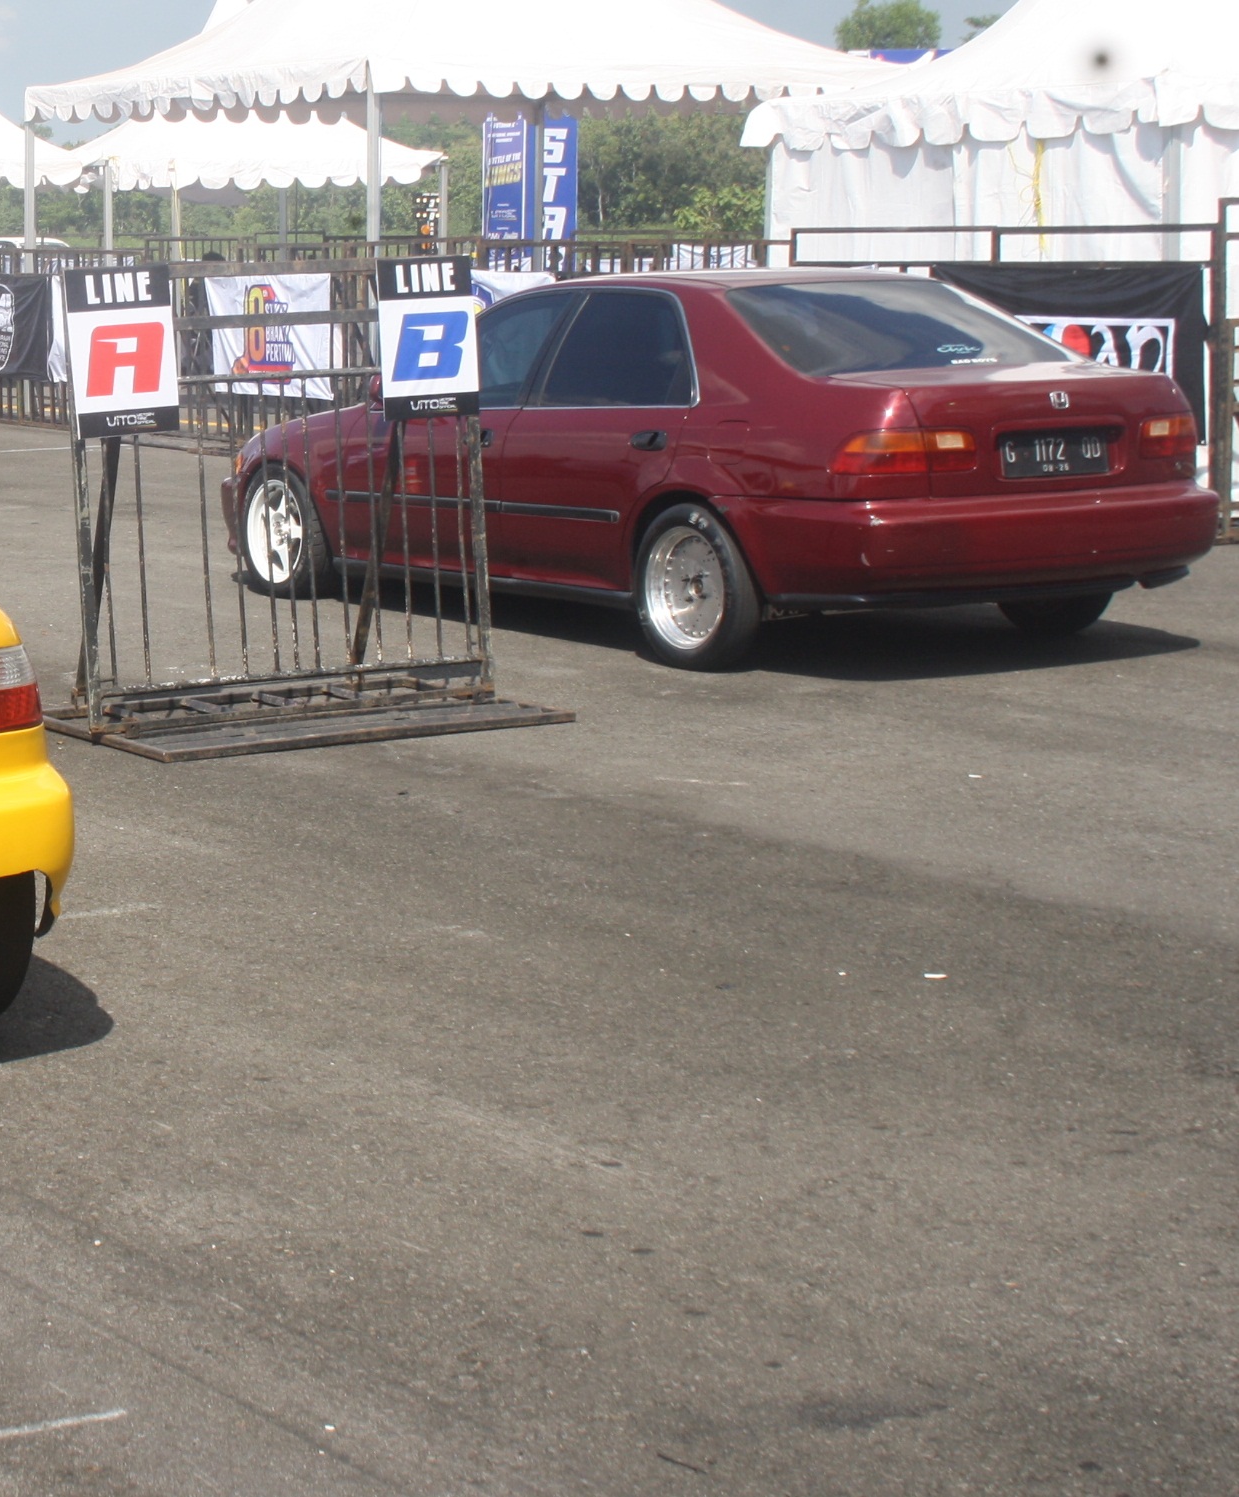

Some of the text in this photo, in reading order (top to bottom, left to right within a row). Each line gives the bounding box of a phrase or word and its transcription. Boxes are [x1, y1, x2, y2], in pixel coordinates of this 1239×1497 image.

[85, 271, 152, 305] LINE
[395, 262, 456, 294] LINE
[86, 322, 165, 398] A
[391, 310, 470, 382] B
[1005, 441, 1016, 463] G
[1035, 438, 1066, 461] 1172
